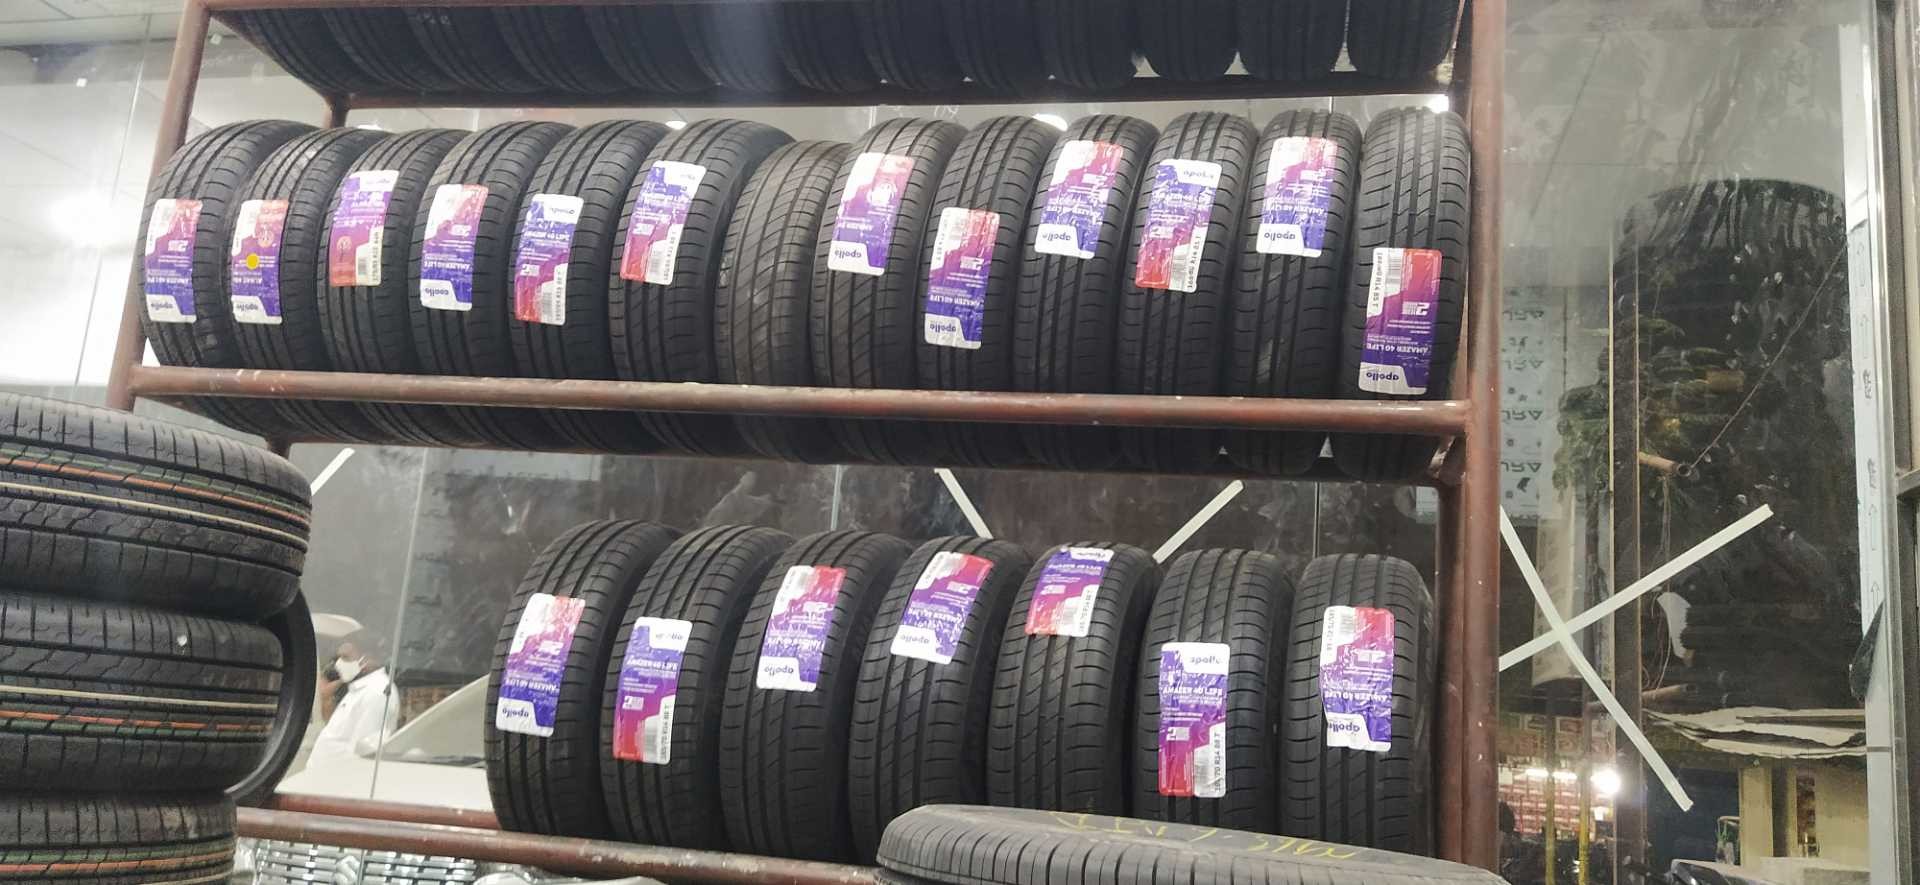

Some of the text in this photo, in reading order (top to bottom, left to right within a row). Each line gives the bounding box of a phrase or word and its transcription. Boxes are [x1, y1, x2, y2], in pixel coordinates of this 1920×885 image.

[1264, 231, 1296, 241] apollo
[1366, 343, 1384, 352] LIFE
[1366, 372, 1399, 381] apollo
